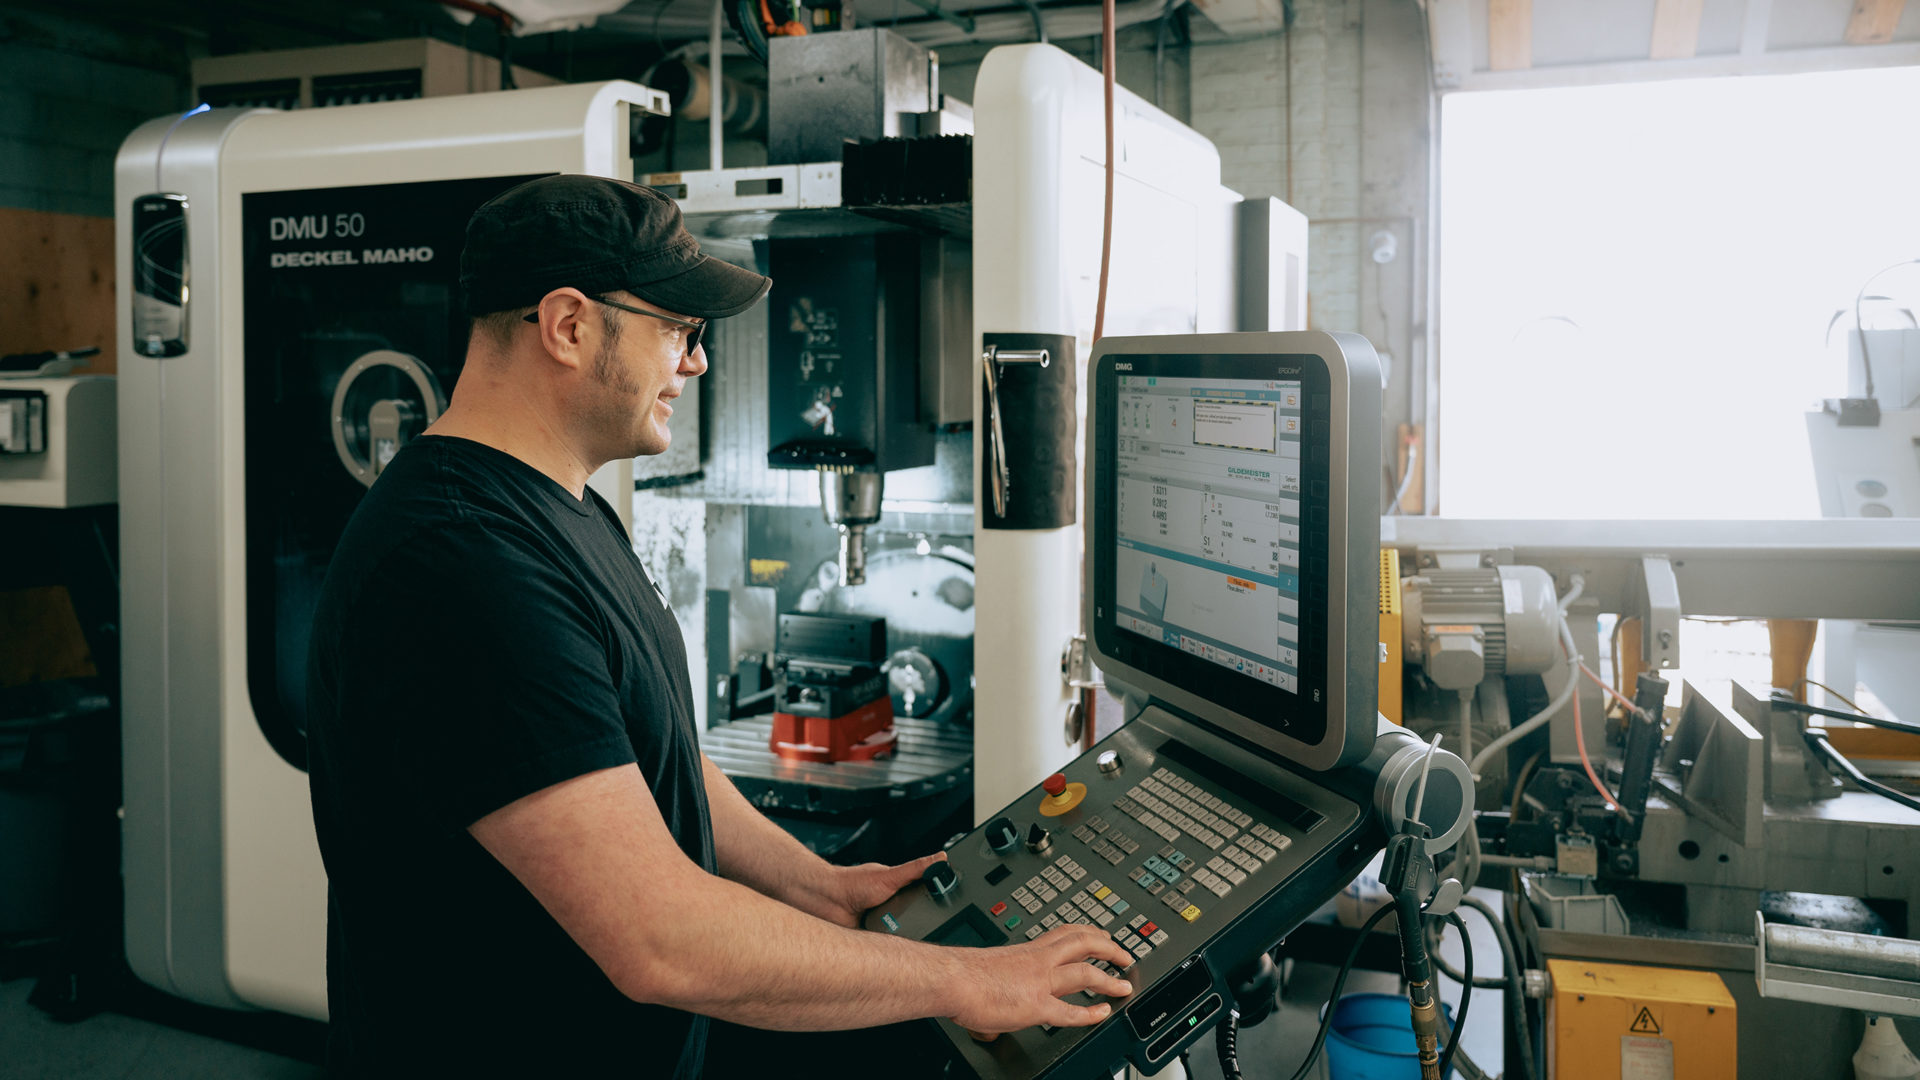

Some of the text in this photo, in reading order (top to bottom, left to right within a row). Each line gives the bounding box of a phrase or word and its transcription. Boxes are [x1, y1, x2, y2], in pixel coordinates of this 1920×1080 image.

[270, 213, 365, 241] DMU 50
[271, 247, 434, 268] DECKEL MAHO
[1115, 363, 1133, 371] DMG
[1227, 466, 1271, 478] GILDEMEISTER
